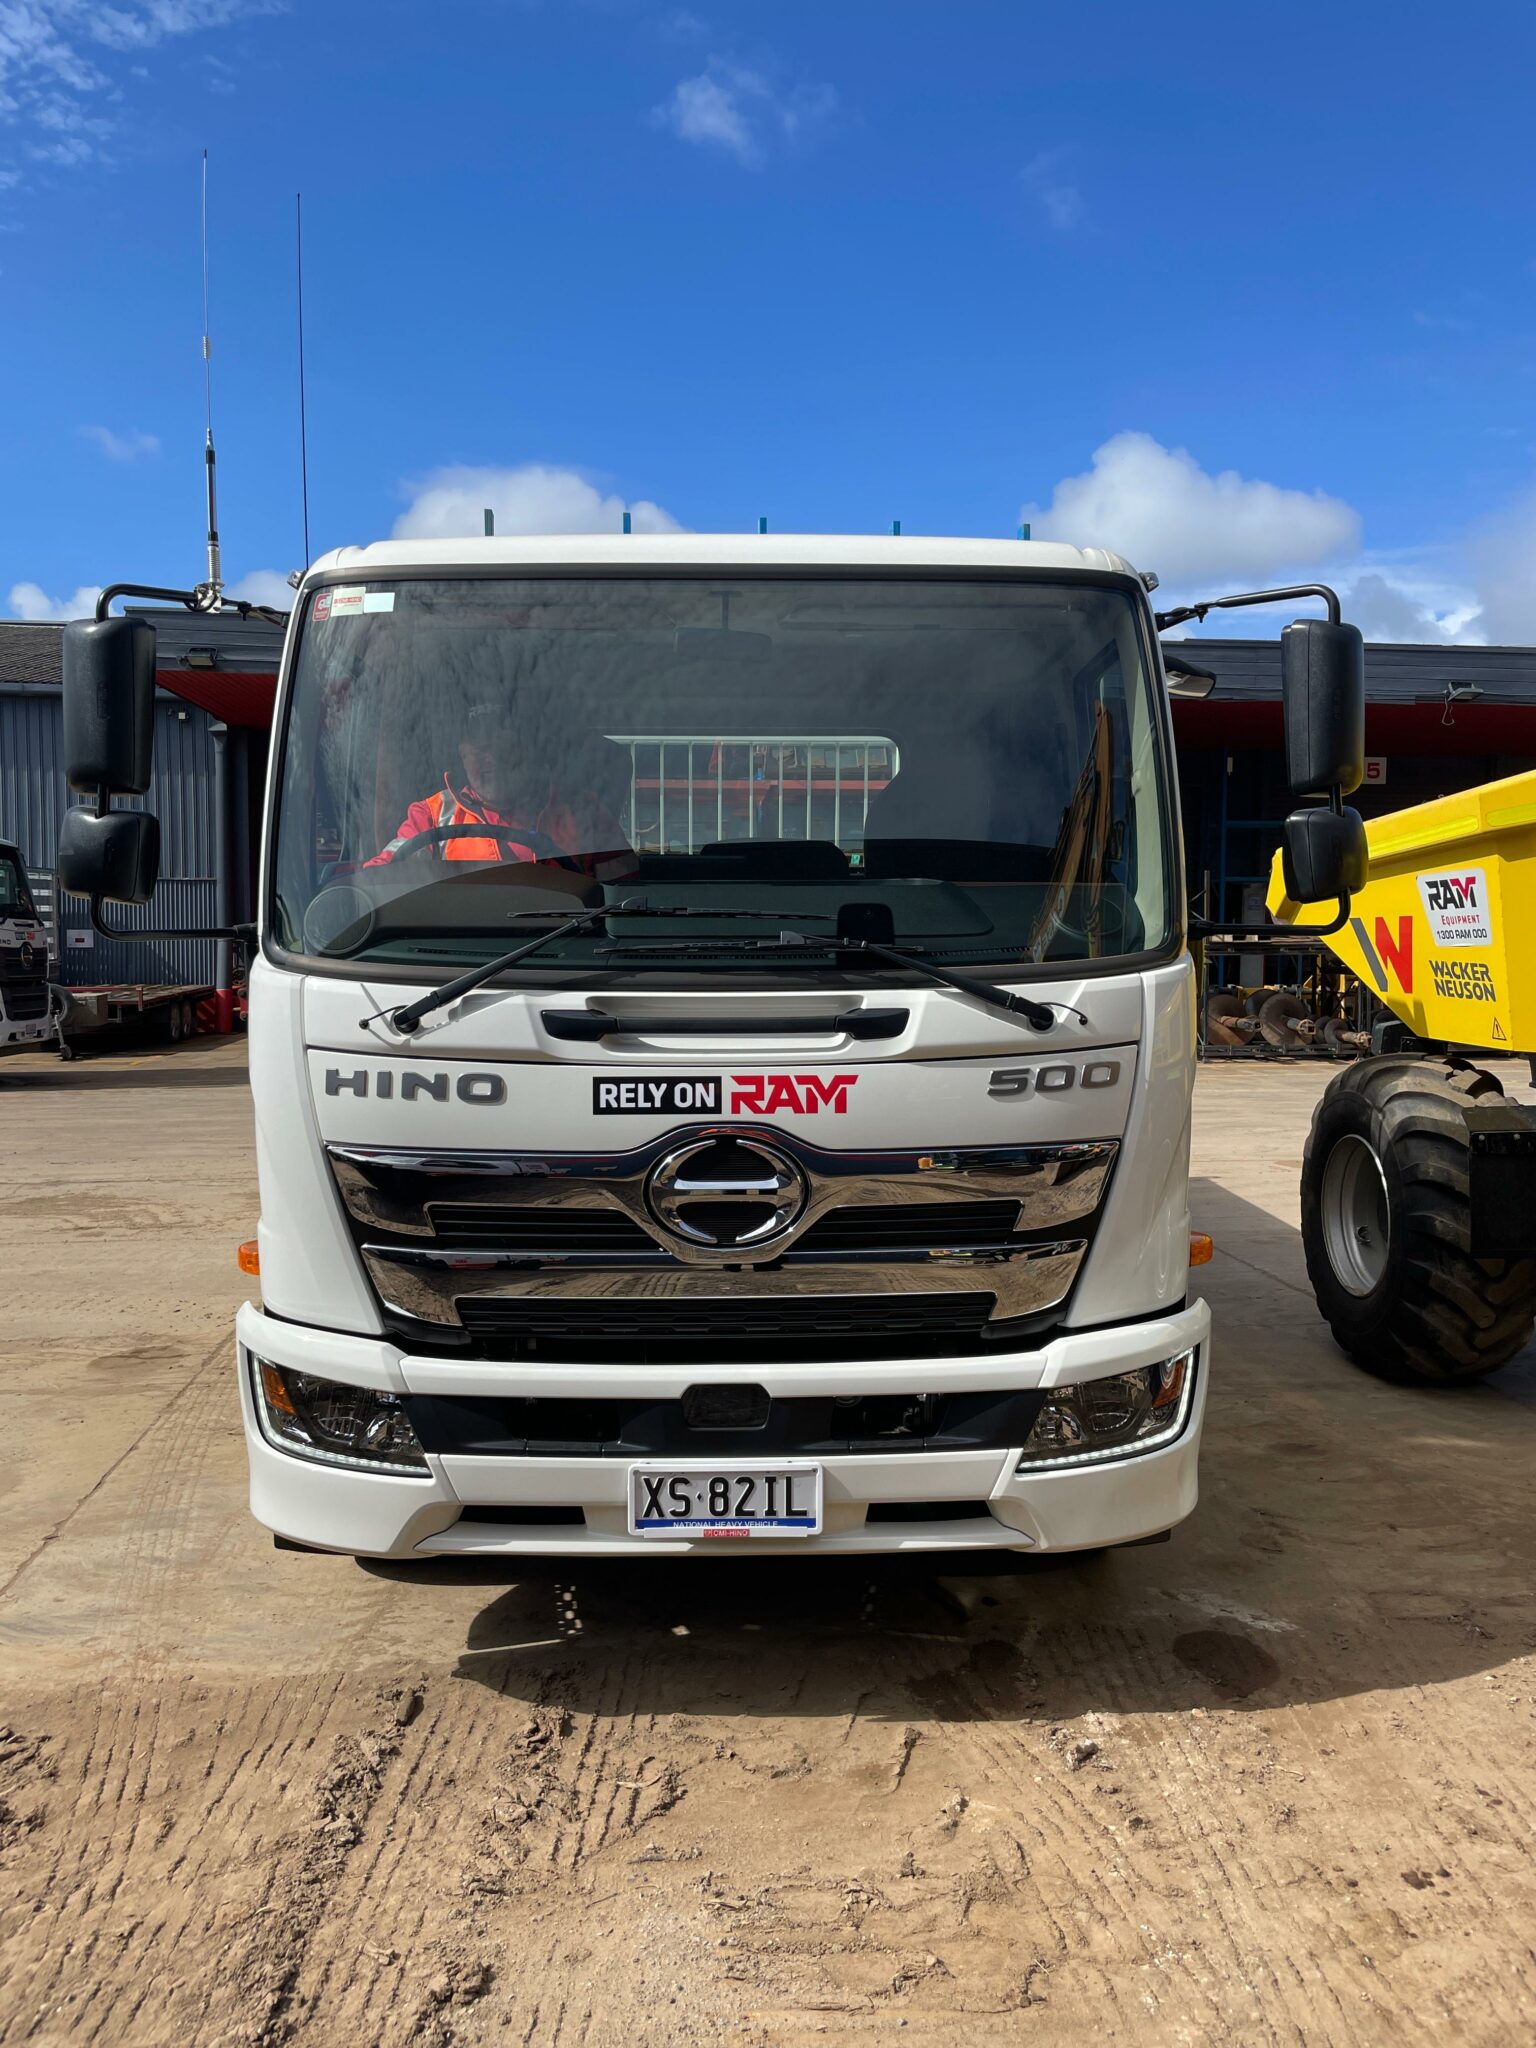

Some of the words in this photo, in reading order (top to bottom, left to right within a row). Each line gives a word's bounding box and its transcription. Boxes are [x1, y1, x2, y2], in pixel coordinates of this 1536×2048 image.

[1367, 762, 1380, 779] 5
[1425, 876, 1477, 911] RAM
[1437, 930, 1454, 940] 1300
[1455, 929, 1472, 940] RAM
[1473, 928, 1488, 939] 000
[1429, 960, 1493, 982] WACKER
[1434, 978, 1497, 1002] NEUSON
[325, 1068, 506, 1104] HINO
[987, 1061, 1121, 1097] 500
[600, 1083, 667, 1108] RELY
[674, 1082, 715, 1108] ON
[730, 1075, 859, 1114] RAM
